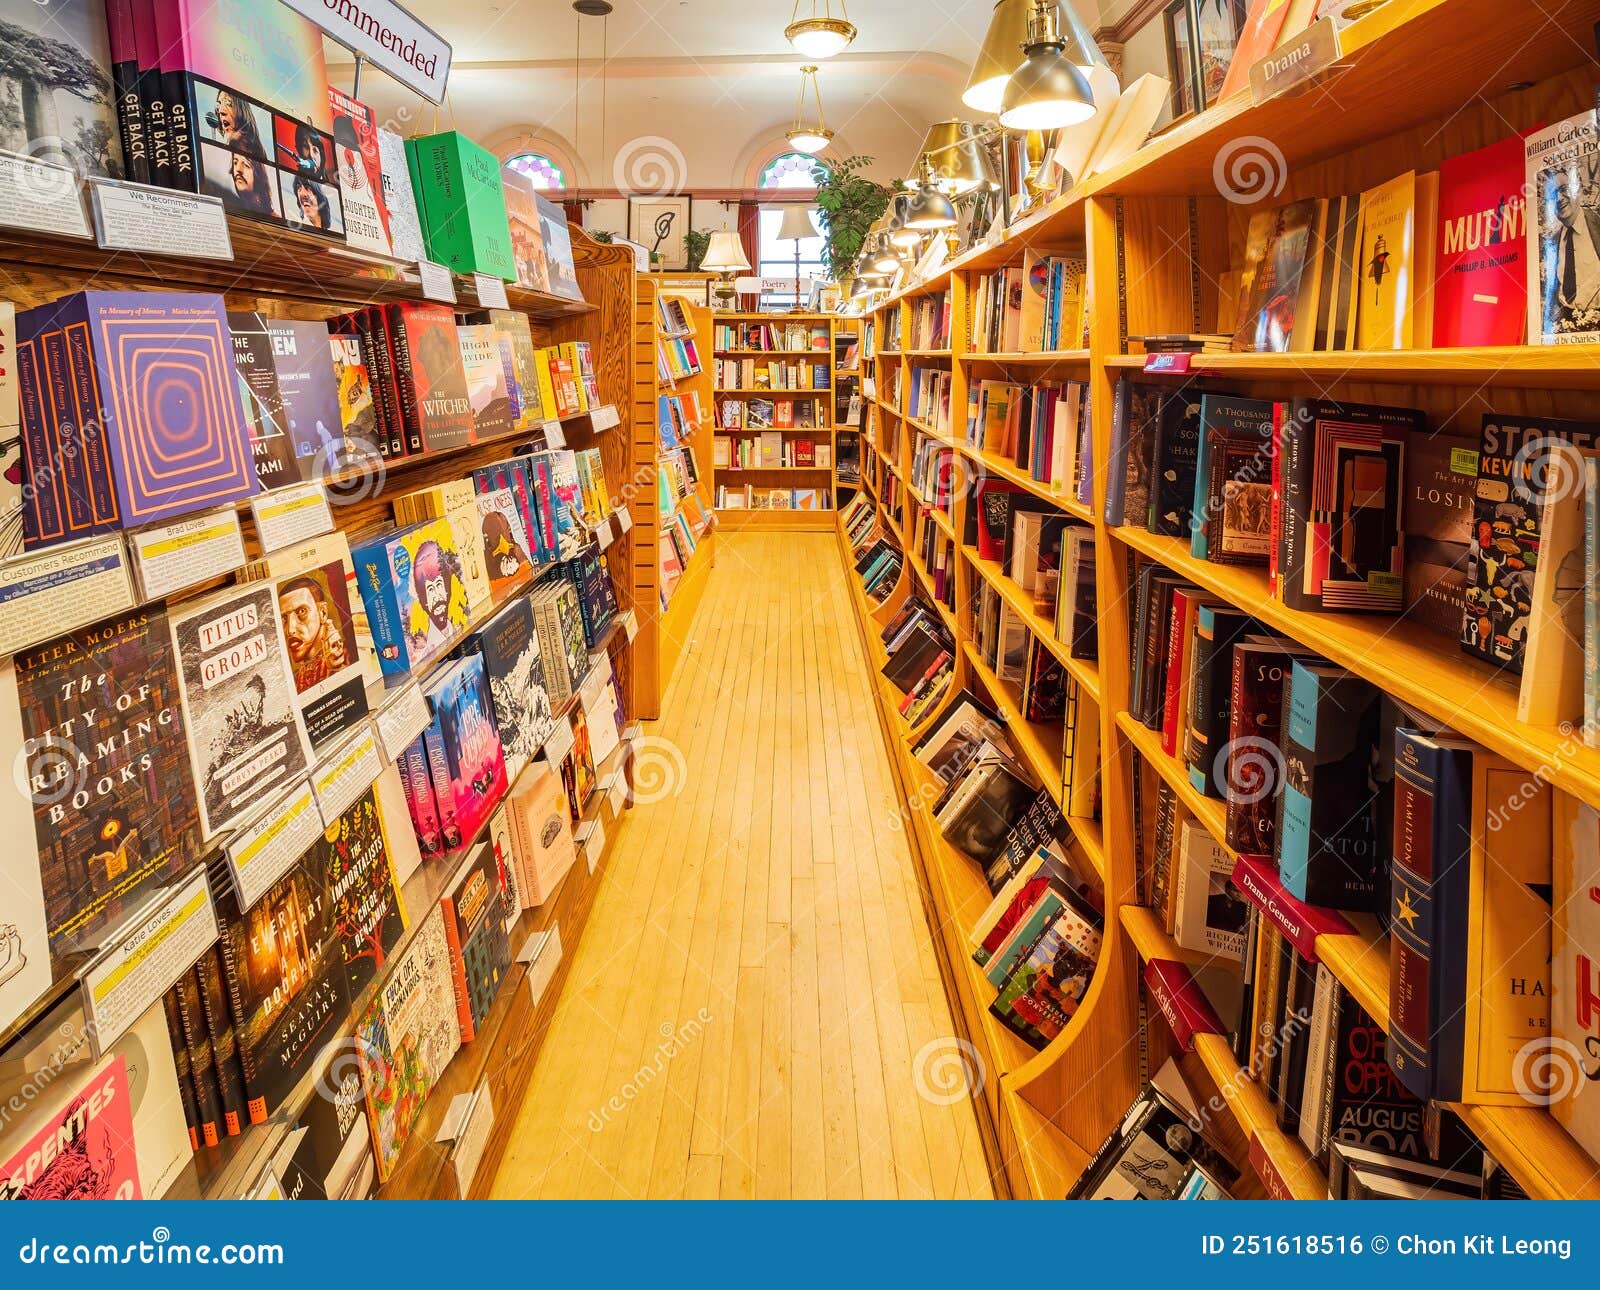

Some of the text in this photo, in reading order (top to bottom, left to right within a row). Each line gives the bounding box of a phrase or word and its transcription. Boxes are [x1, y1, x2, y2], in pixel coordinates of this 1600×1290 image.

[324, 0, 437, 80] ommended
[1263, 41, 1312, 81] Drama
[125, 93, 146, 161] GET BACK
[151, 100, 170, 168] GET BACK
[172, 104, 192, 172] GET BACK
[1527, 126, 1590, 158] William Carlos
[0, 159, 44, 175] ommend
[1542, 144, 1580, 167] Selected
[129, 190, 199, 209] We Recommend
[344, 197, 378, 220] AUGHTER
[1454, 258, 1479, 274] PHILLIP
[761, 279, 787, 290] Poetry
[423, 398, 470, 417] WITCHER
[1225, 407, 1271, 419] THOUSAND
[1234, 420, 1255, 429] OUT
[1484, 423, 1600, 460] STONE
[1435, 472, 1449, 482] The
[1451, 475, 1465, 486] Art
[1481, 456, 1533, 480] KEVIN
[166, 519, 206, 537] Brad Loves
[2, 559, 60, 582] Customers
[62, 543, 119, 563] Recommend
[1287, 538, 1295, 567] YOUNG
[1426, 588, 1466, 609] KEVIN YOU
[203, 609, 257, 645] TITUS
[15, 614, 149, 674] ALTER MOERS
[205, 638, 264, 682] GROAN
[62, 673, 106, 702] The
[1258, 665, 1282, 682] SO
[116, 685, 151, 712] OF
[30, 708, 173, 795] REAMING
[49, 754, 152, 825] BOOKS
[1036, 790, 1060, 827] Derek
[1017, 815, 1036, 848] Peter
[1028, 803, 1052, 848] Walcott
[1404, 791, 1414, 863] HAMILTON
[351, 842, 361, 859] THE
[1006, 828, 1026, 865] Doig
[331, 836, 383, 903] IMMORTALISTS
[357, 891, 378, 922] CHLOE
[459, 891, 474, 913] SEEK
[1243, 873, 1301, 939] Drama General
[283, 896, 322, 947] HEART
[1206, 930, 1247, 945] RICHAR
[123, 931, 146, 955] Katie
[1208, 938, 1243, 954] WRIGH
[218, 918, 229, 945] EVERY
[224, 946, 236, 977] HEART
[234, 984, 245, 1027] DOORWAY
[263, 939, 323, 1016] DOORWAY
[281, 979, 330, 1044] SEANAN
[1022, 994, 1065, 1028] CONVERSAT
[1153, 985, 1178, 1028] Acting
[1340, 1107, 1420, 1132] AUGUS
[0, 1075, 116, 1200] SPENTES
